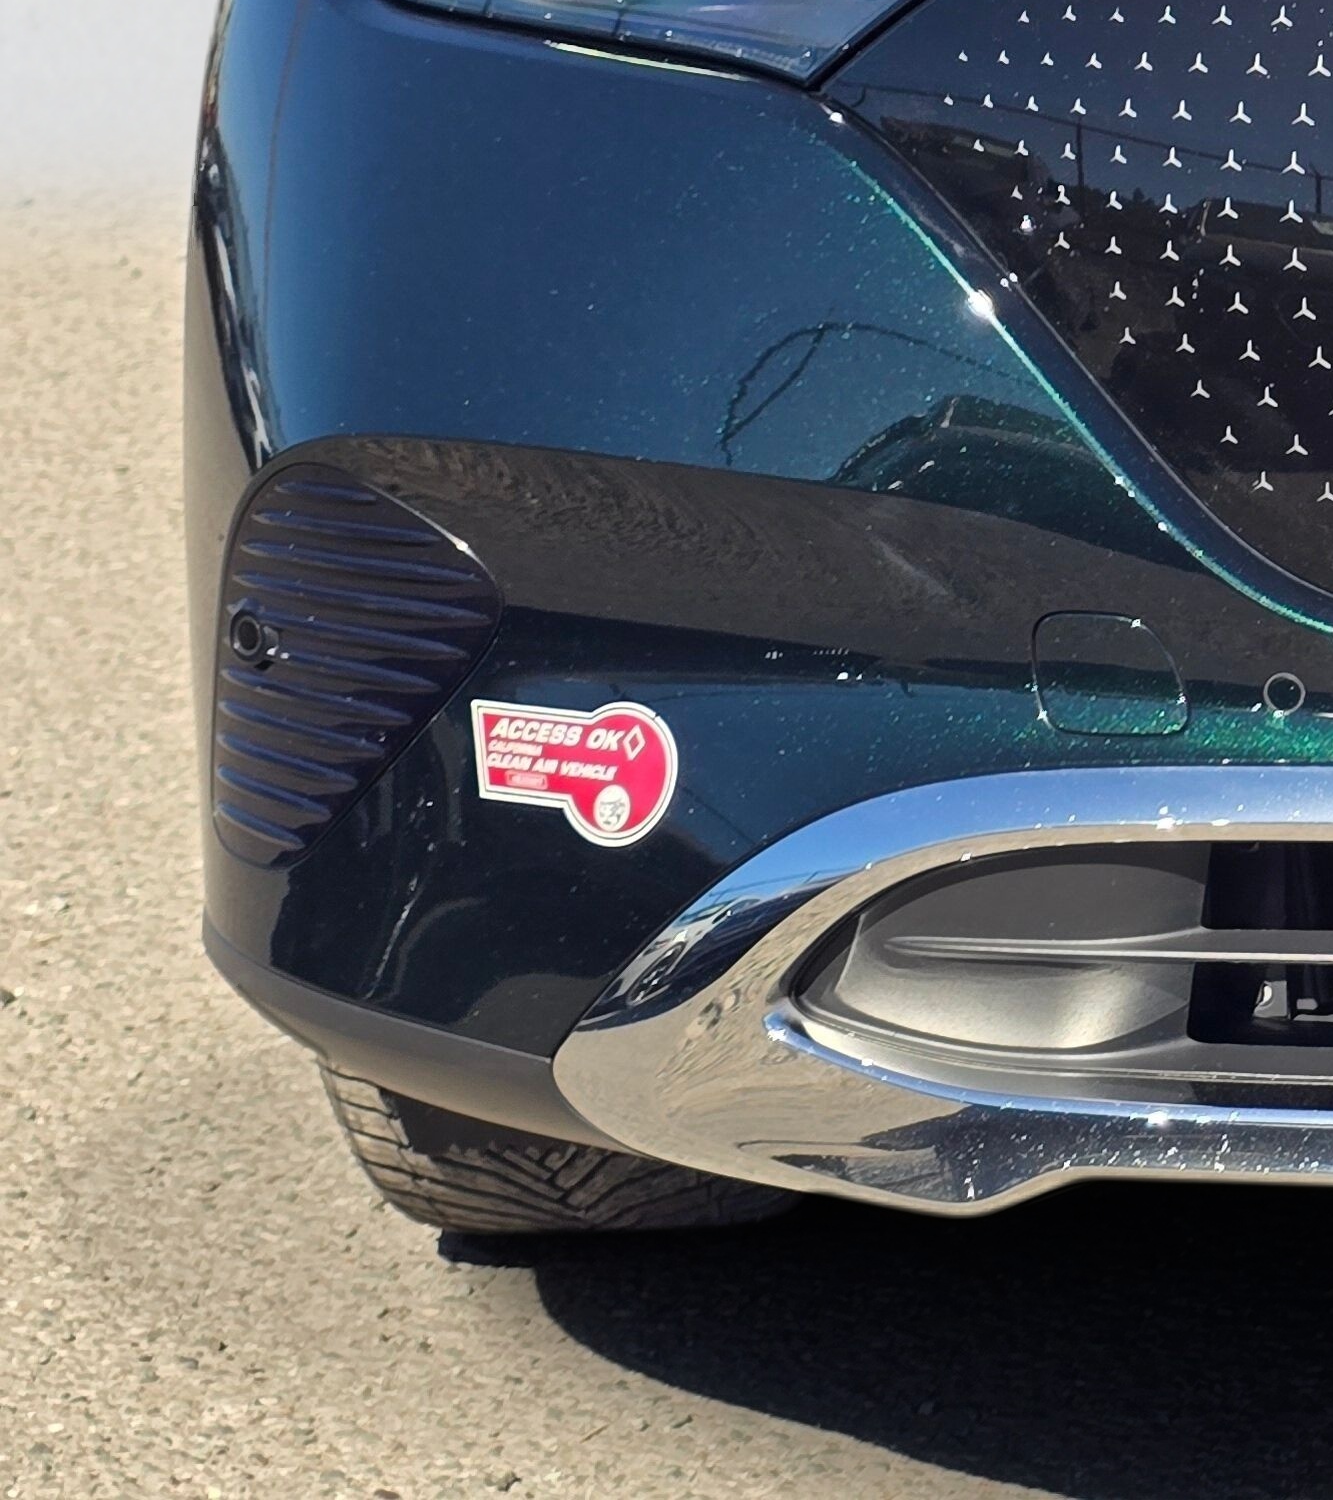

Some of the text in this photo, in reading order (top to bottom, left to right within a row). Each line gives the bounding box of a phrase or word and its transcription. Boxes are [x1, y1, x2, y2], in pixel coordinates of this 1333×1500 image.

[489, 718, 626, 751] ACCESS OK
[486, 752, 533, 773] CLEAN
[532, 758, 559, 774] AIR
[560, 761, 619, 782] VEHICLE
